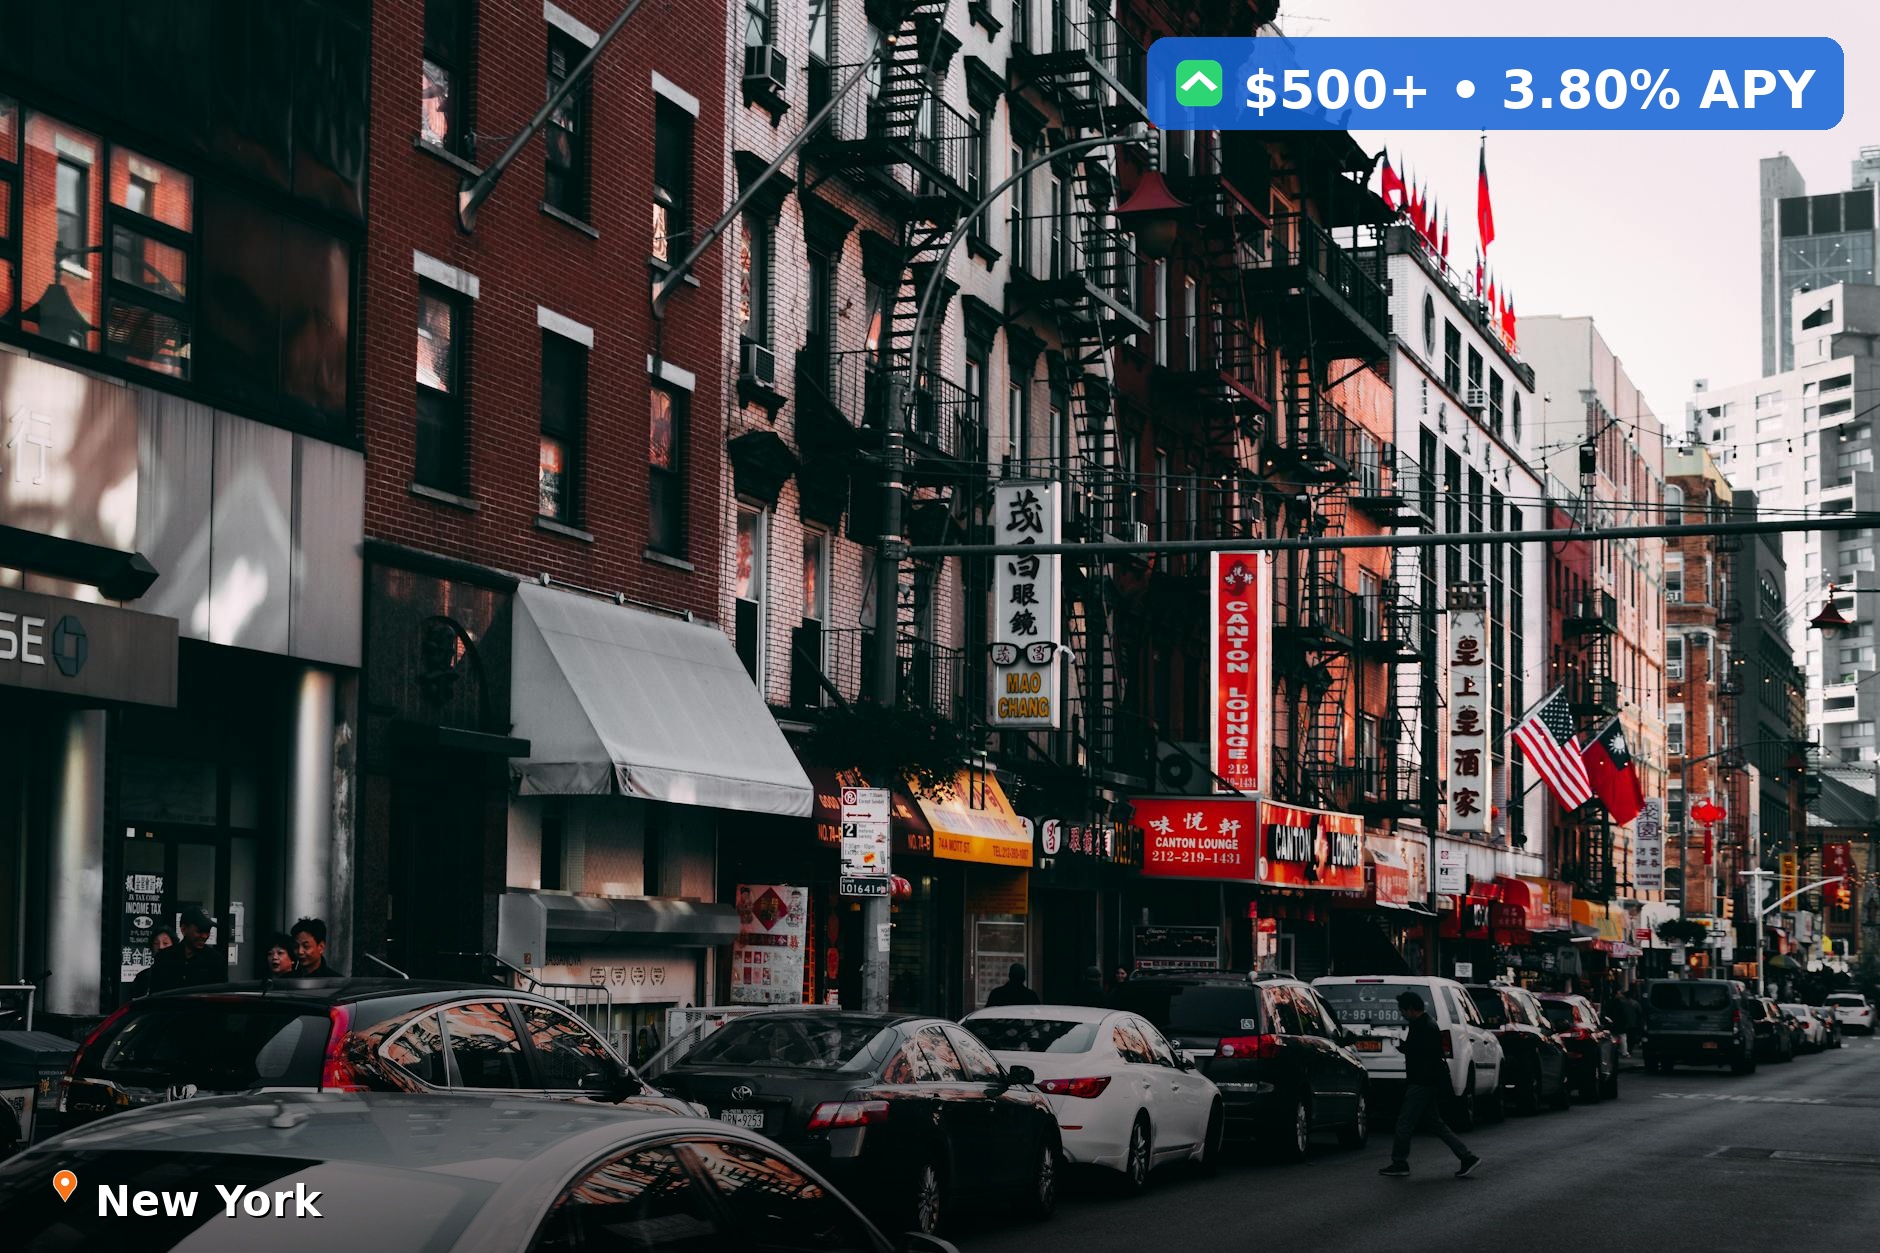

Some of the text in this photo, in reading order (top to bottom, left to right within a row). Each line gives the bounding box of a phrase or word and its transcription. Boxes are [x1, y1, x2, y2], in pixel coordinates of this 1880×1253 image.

[1006, 672, 1041, 694] MAO
[1226, 601, 1249, 760] CANTON LOUNGE
[998, 697, 1049, 719] CHANG
[1451, 634, 1484, 818] 皇上皇酒家
[1228, 764, 1249, 774] 212
[845, 824, 854, 837] 2
[1155, 837, 1239, 850] CANTON LOUNGE
[1275, 824, 1311, 862] CANTON
[1152, 851, 1241, 865] 212-219-1431
[842, 884, 875, 893] 101641
[125, 902, 162, 915] INCOME TAX
